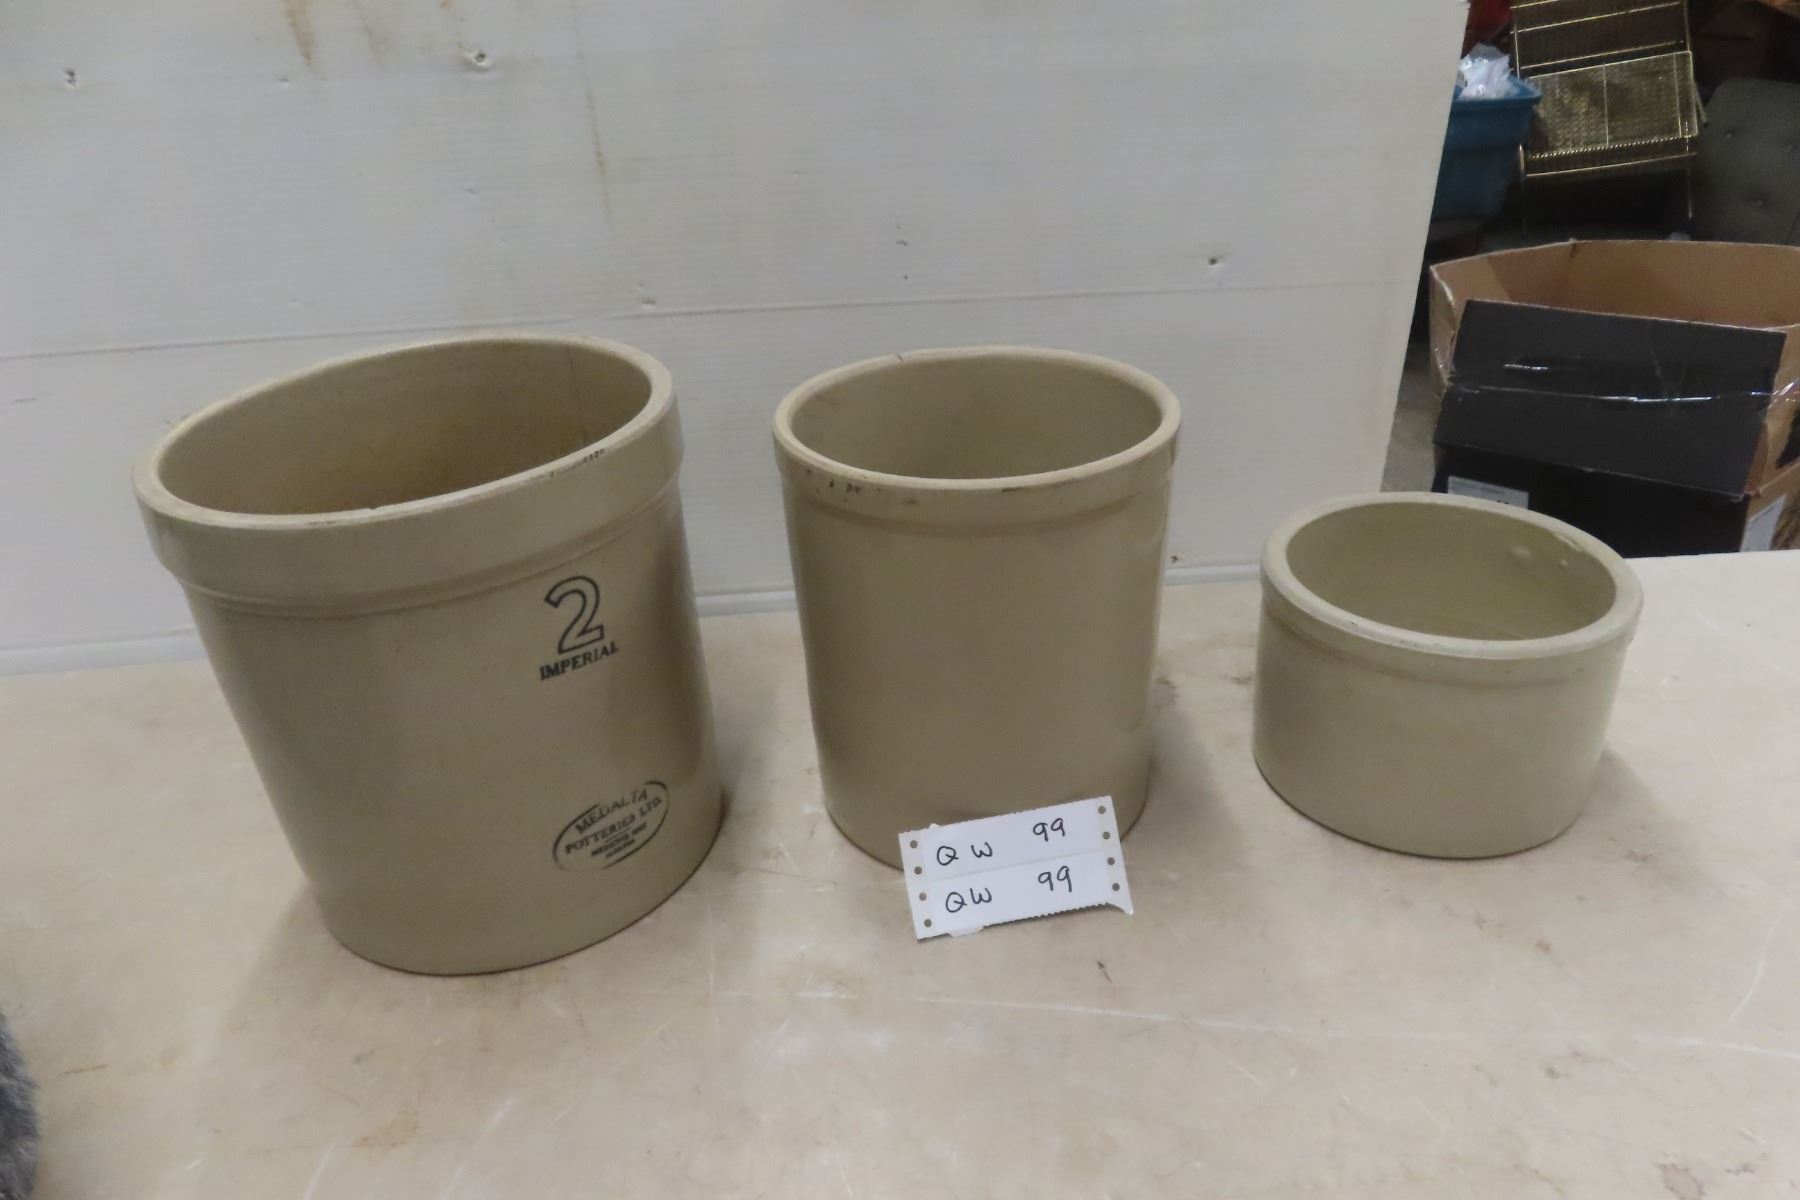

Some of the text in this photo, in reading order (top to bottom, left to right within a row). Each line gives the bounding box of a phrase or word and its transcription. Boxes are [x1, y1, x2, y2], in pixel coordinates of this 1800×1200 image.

[544, 575, 604, 654] 2
[539, 641, 619, 680] IMPERIAL
[575, 788, 648, 834] MEDALTA
[1032, 817, 1066, 842] 99
[1037, 865, 1073, 893] 99
